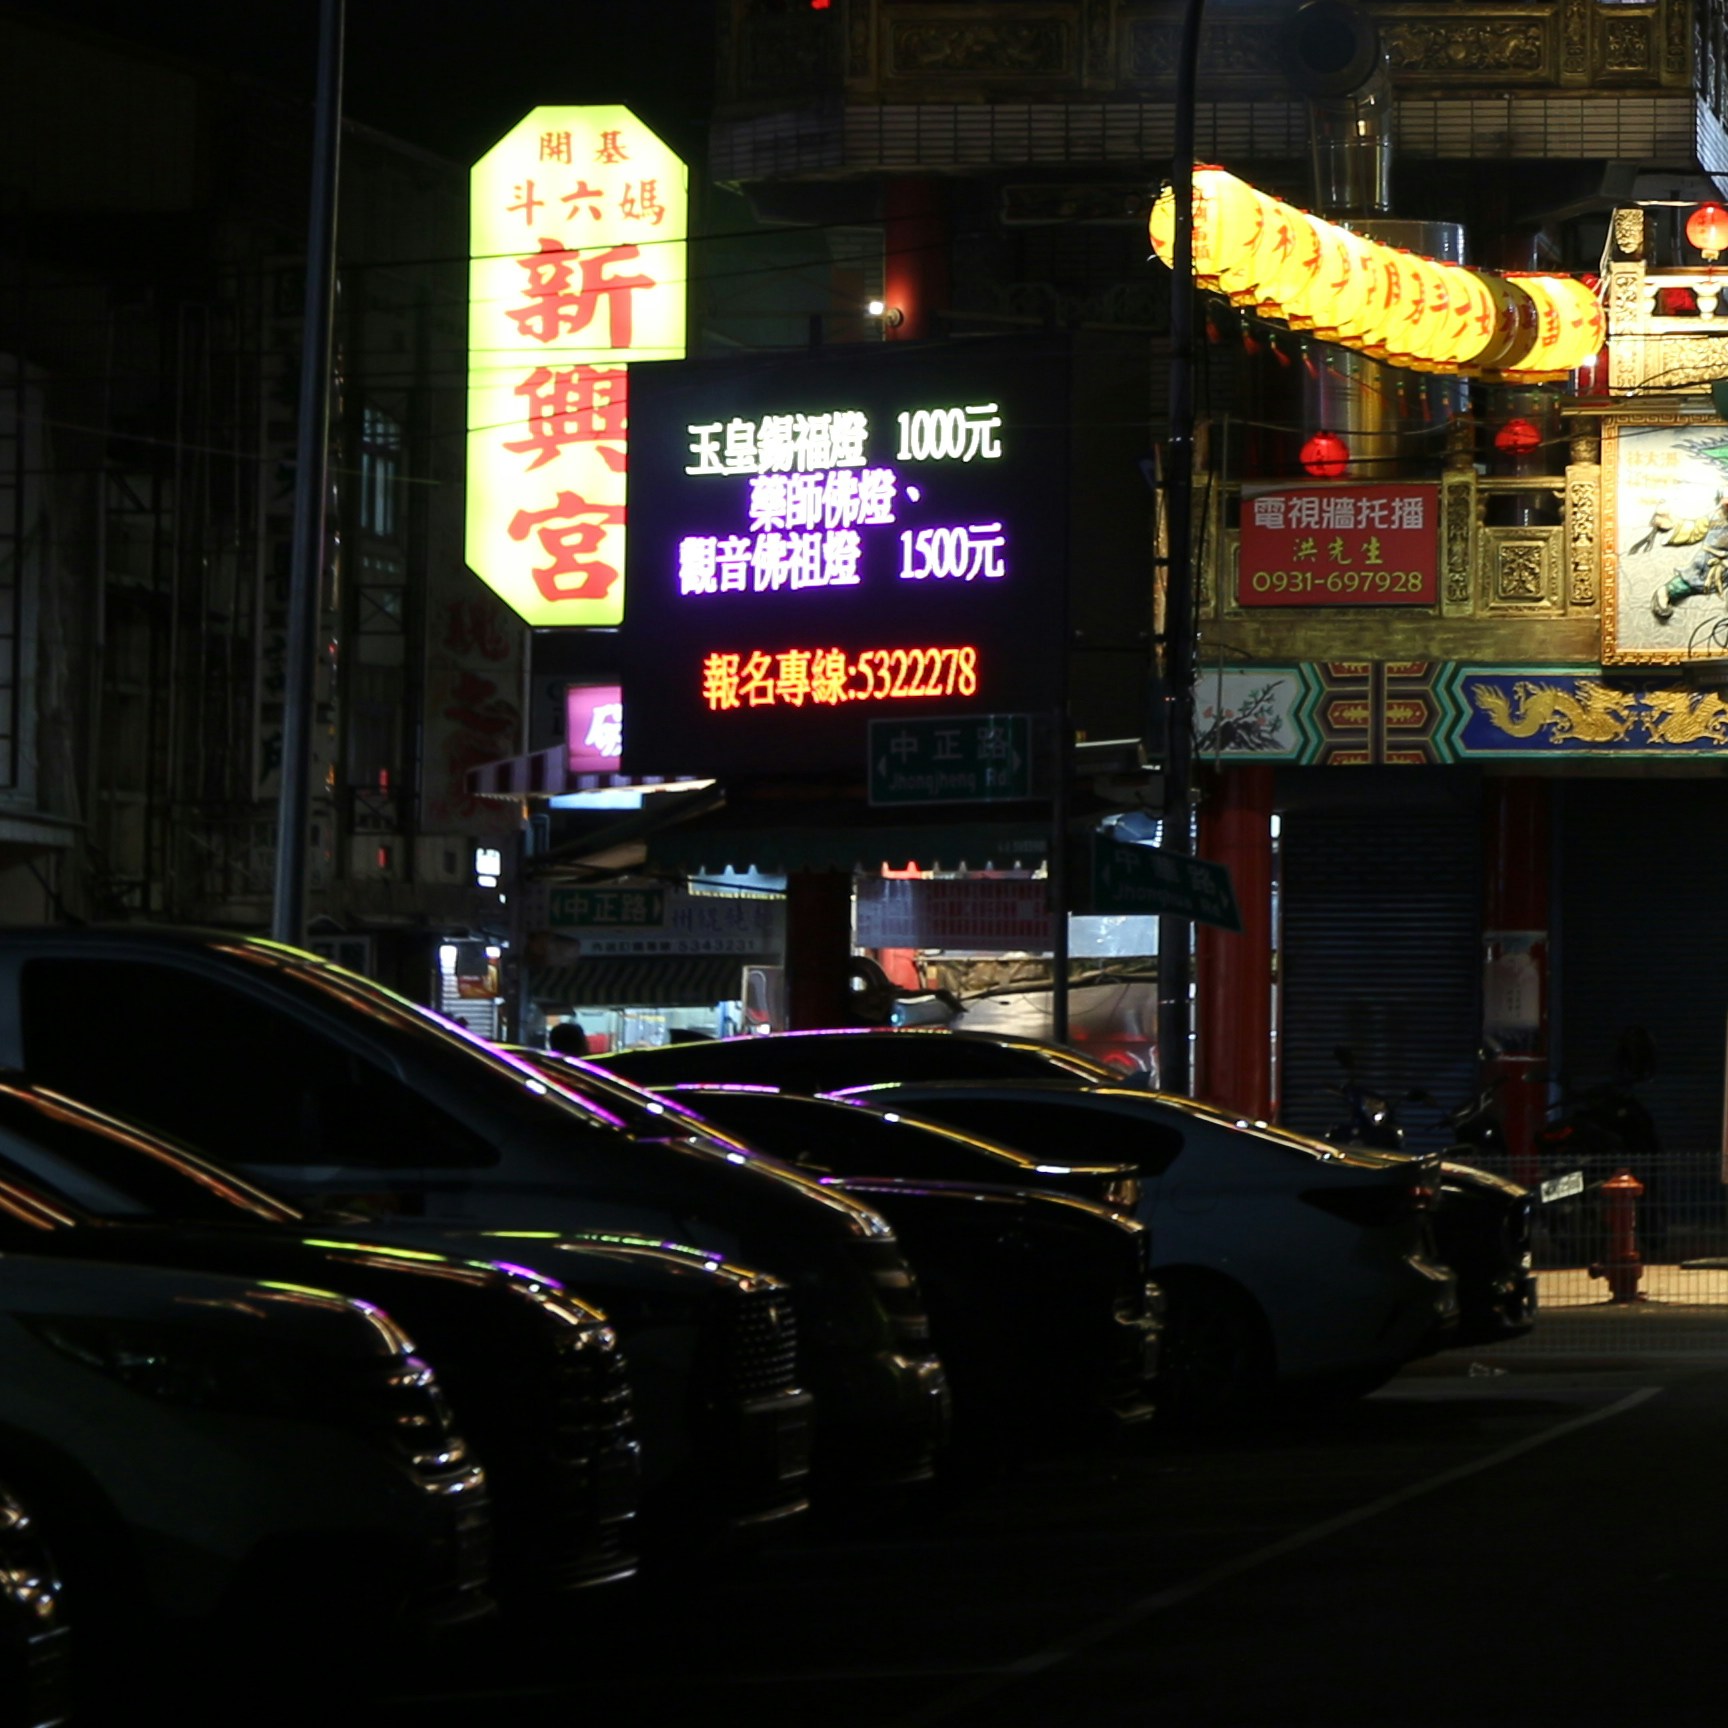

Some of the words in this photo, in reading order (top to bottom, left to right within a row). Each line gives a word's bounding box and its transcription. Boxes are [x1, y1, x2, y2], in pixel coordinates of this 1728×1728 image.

[539, 130, 631, 164] 開基
[506, 180, 666, 227] 斗六媽
[505, 238, 656, 603] 新興宮
[896, 402, 1003, 463] 1000元
[1253, 495, 1425, 531] 電視牆托播
[679, 529, 862, 596] 觀音佛祖燈
[900, 522, 1007, 582] 1500元
[1291, 535, 1386, 566] 洪先生
[1251, 570, 1424, 594] 0931-697928
[888, 727, 1010, 765] 中正路
[563, 893, 649, 924] 中正路
